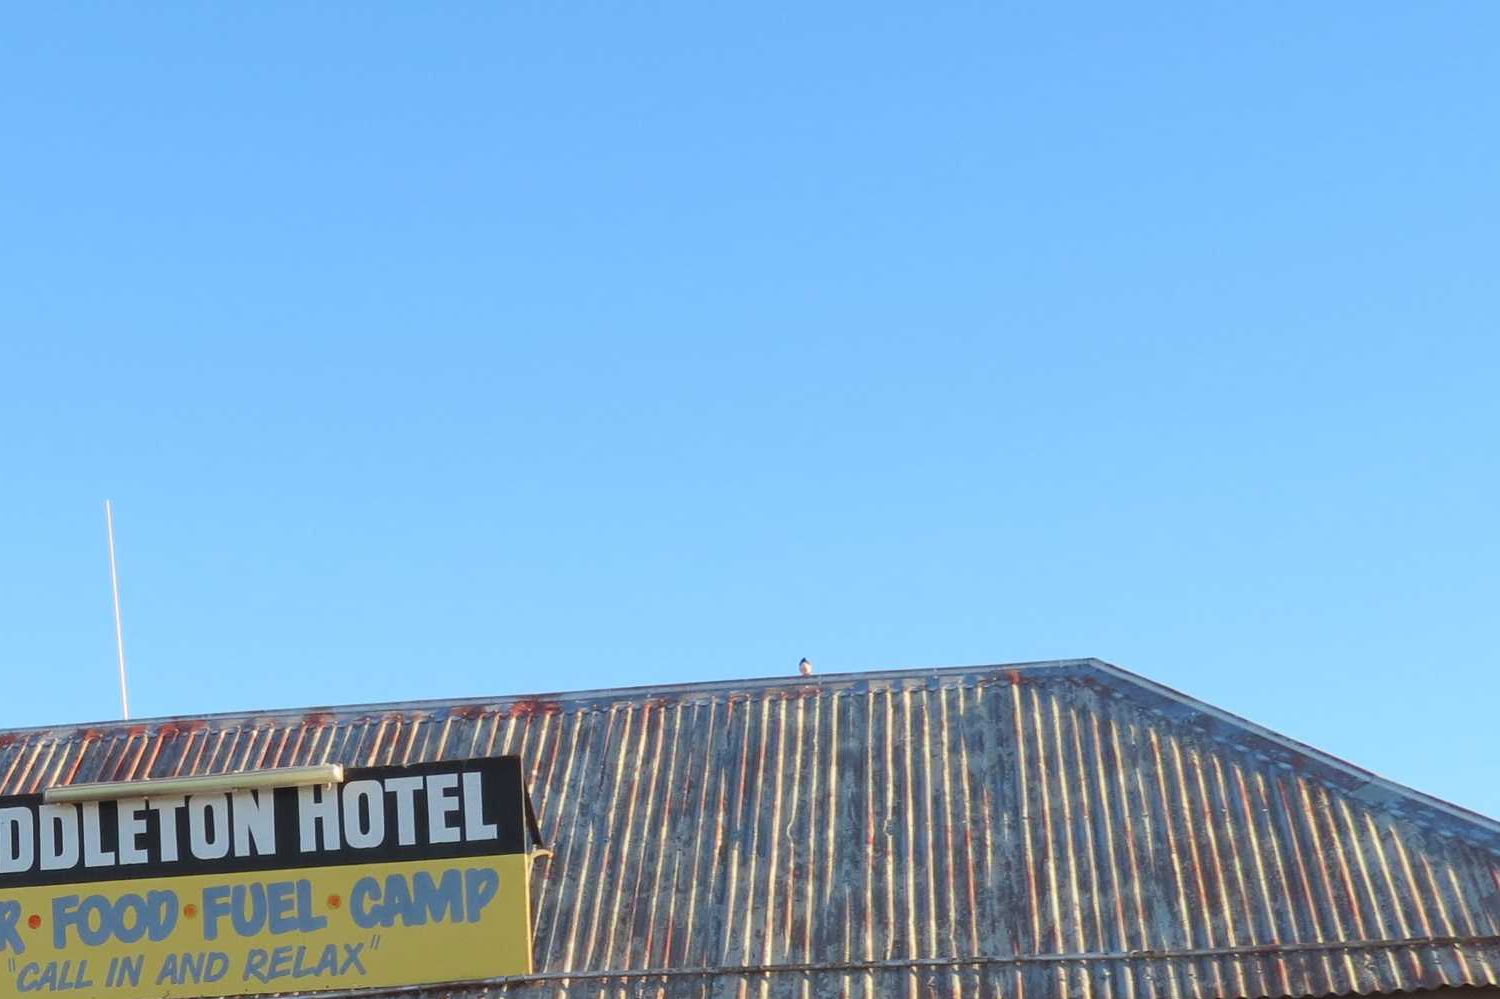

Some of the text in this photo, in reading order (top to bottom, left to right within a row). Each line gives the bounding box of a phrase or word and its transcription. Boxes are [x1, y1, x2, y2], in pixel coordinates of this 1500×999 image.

[299, 771, 498, 853] HOTEL
[52, 889, 179, 949] FOOD
[202, 879, 327, 940] FUEL
[350, 868, 499, 929] CAMP
[105, 954, 145, 988] IN
[156, 951, 229, 986] AND
